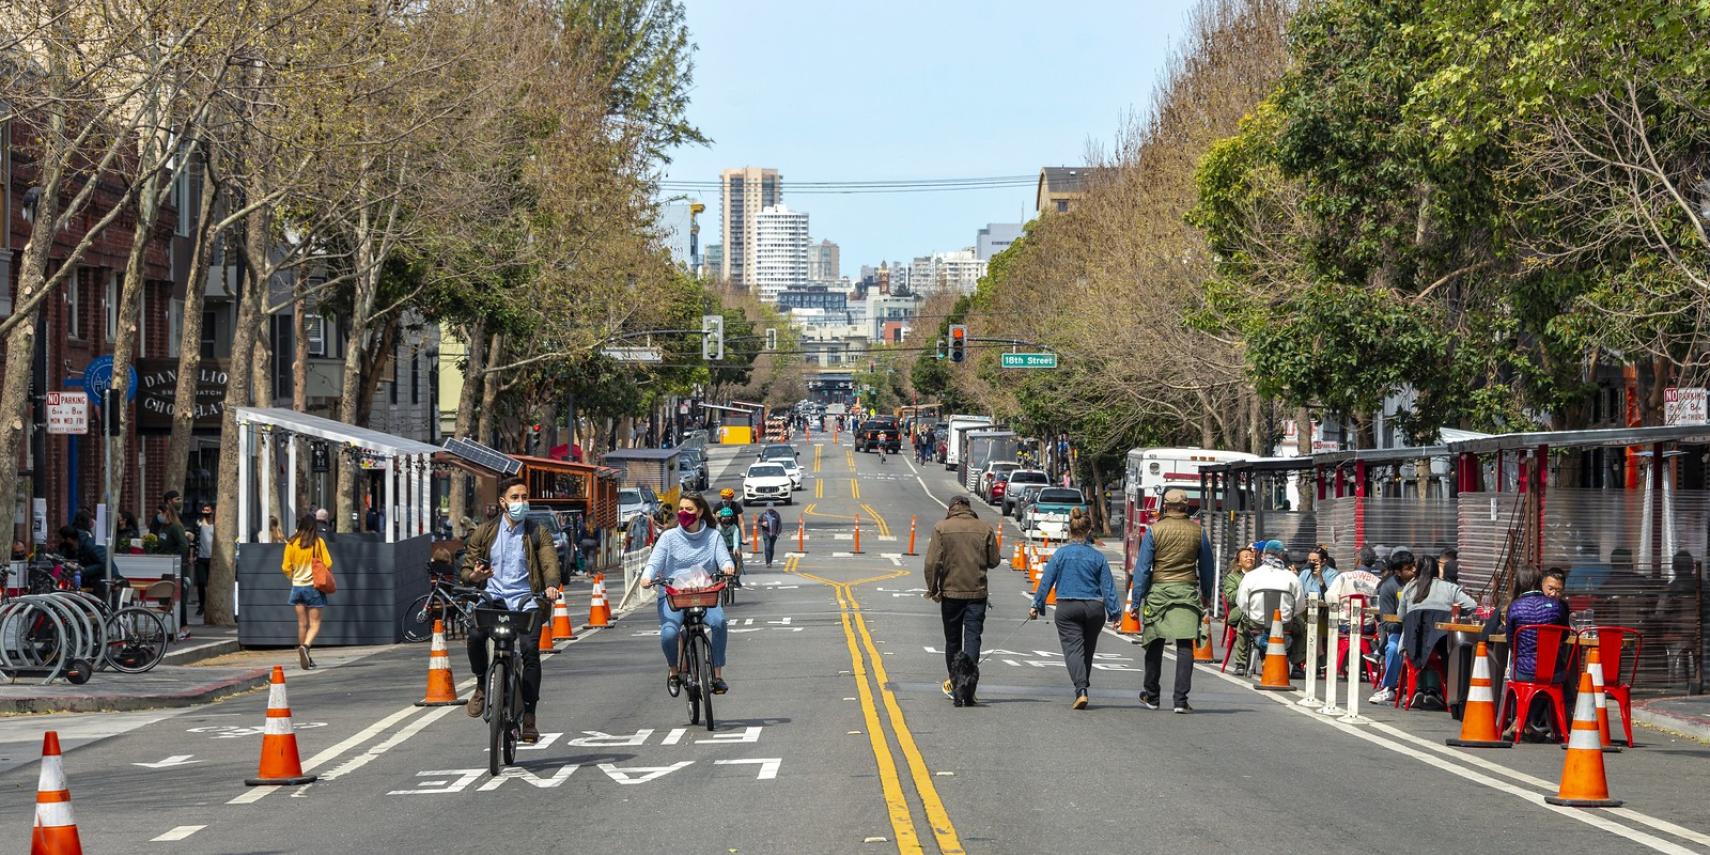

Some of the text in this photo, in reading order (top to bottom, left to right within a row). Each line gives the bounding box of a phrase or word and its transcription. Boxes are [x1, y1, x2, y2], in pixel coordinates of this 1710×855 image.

[1005, 356, 1053, 365] 18th Street
[48, 393, 59, 405] NO
[1666, 390, 1678, 401] NO
[386, 758, 782, 795] LANE
